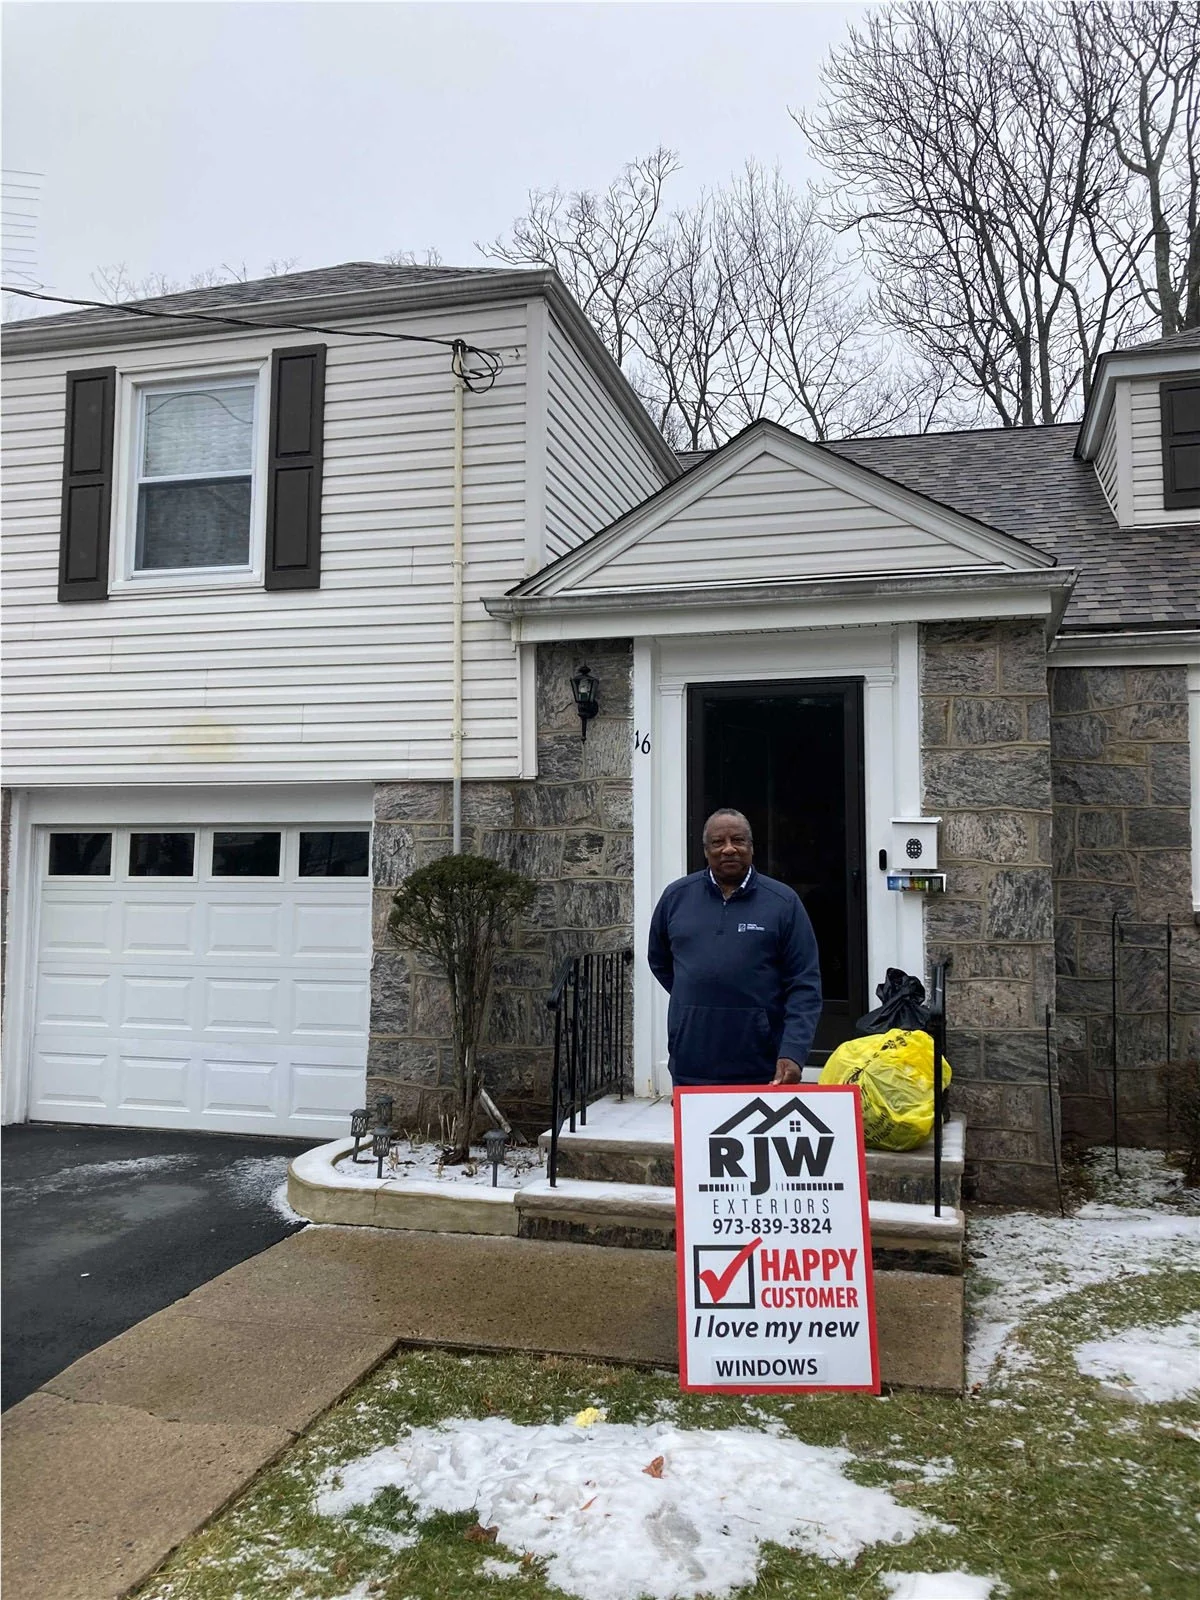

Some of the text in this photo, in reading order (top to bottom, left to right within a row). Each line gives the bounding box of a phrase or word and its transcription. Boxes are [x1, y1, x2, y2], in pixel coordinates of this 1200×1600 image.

[635, 729, 651, 755] 16
[709, 1136, 835, 1196] RJW
[713, 1198, 830, 1214] EXTERIORS
[712, 1217, 832, 1235] 973-839-3824
[760, 1248, 858, 1281] HAPPY
[760, 1287, 859, 1308] CUSTOMER
[694, 1315, 859, 1344] I love my new
[716, 1358, 818, 1377] WINDOWS
